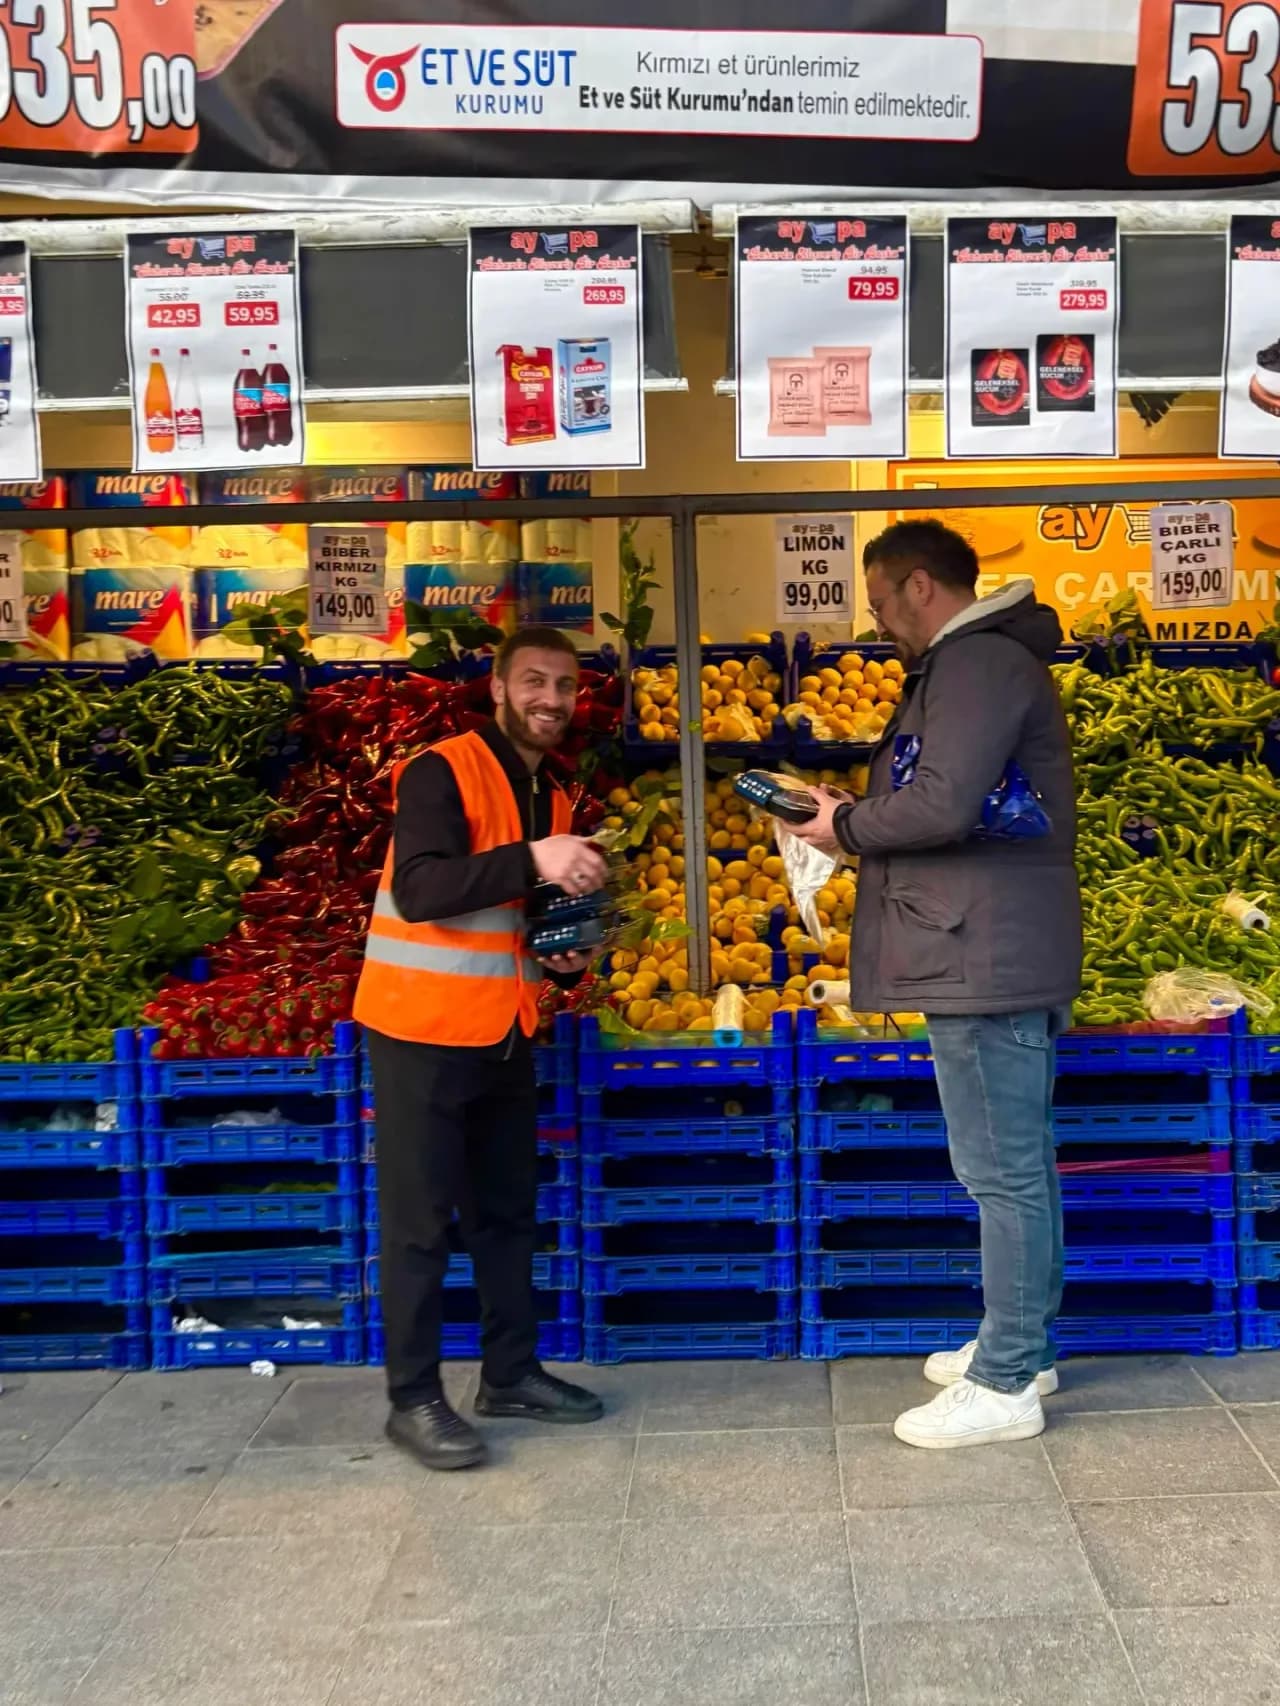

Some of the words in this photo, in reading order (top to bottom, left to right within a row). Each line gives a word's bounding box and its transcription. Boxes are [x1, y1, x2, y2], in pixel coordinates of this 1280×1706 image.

[0, 0, 197, 143] 35,00
[420, 47, 458, 85] ET
[465, 48, 505, 86] VE
[513, 49, 577, 87] SÜT
[636, 51, 710, 75] Kırmızı
[717, 54, 738, 76] et
[744, 53, 861, 78] ürünlerimiz
[1160, 1, 1280, 157] 53
[455, 93, 544, 115] KURUMU
[578, 85, 598, 108] Et
[603, 89, 625, 109] ve
[630, 87, 661, 110] Süt
[797, 90, 849, 116] temin
[854, 91, 971, 119] edilmektedir.
[510, 231, 538, 254] ay
[569, 230, 599, 253] pa
[777, 220, 807, 244] ay
[836, 220, 867, 243] pa
[988, 221, 1017, 246] ay
[1047, 222, 1077, 245] pa
[167, 237, 196, 260] ay
[225, 235, 257, 257] pa
[585, 289, 625, 304] 269,95
[852, 281, 896, 299] 79,95
[1062, 292, 1106, 309] 279,95
[151, 308, 198, 325] 42,95
[228, 306, 275, 324] 59,95
[95, 474, 167, 495] mare
[223, 475, 294, 496] mare
[329, 475, 399, 496] mare
[432, 471, 504, 491] mare
[1038, 503, 1116, 552] ay
[1159, 523, 1221, 537] BIBER
[321, 547, 371, 558] BIBER
[783, 535, 846, 552] LIMON
[1160, 537, 1222, 553] ÇARLI
[315, 561, 377, 573] KIRMIZI
[801, 559, 829, 576] KG
[1177, 553, 1207, 565] KG
[335, 576, 358, 587] KG
[1162, 569, 1222, 598] 159,00
[95, 589, 165, 610] mare
[423, 584, 497, 606] mare
[785, 582, 844, 612] 99,00
[0, 600, 12, 623] 0
[315, 593, 375, 623] 149,00
